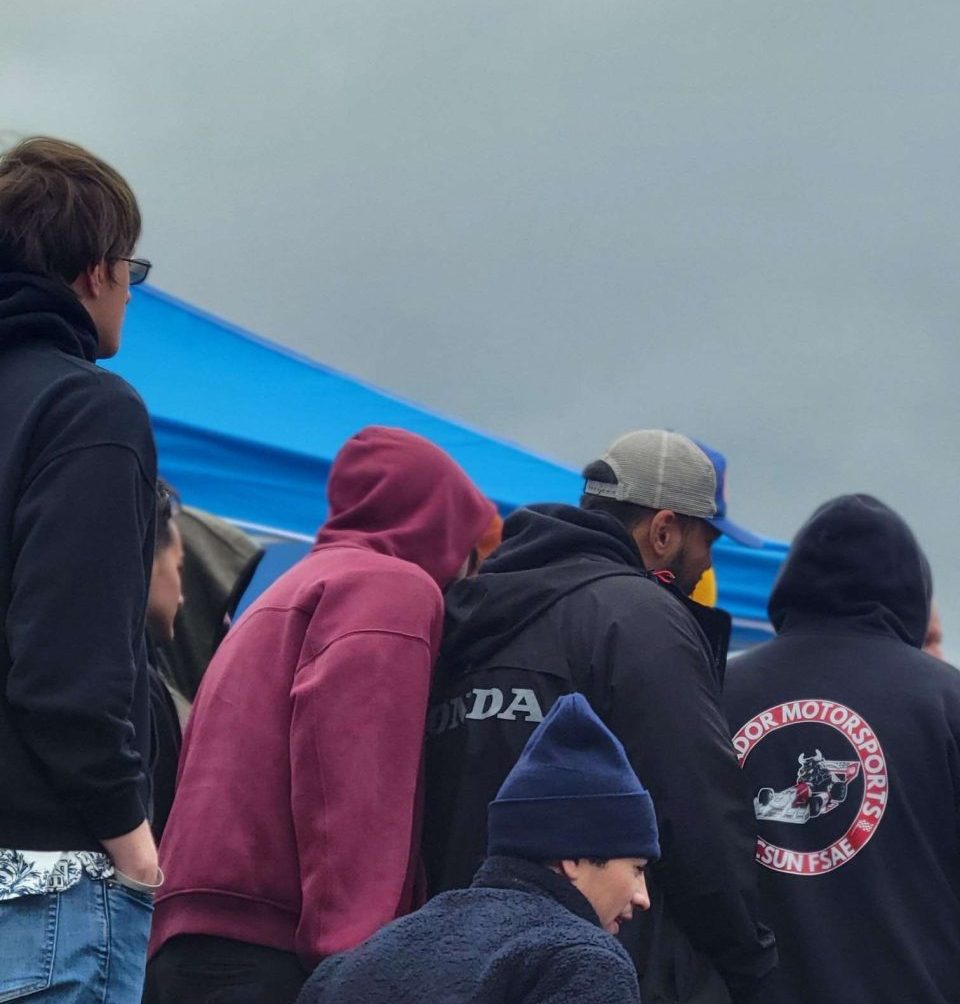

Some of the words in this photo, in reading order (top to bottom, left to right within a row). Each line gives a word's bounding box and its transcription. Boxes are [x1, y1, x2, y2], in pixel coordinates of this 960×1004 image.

[428, 688, 545, 732] ONDA
[732, 711, 780, 758] DOR
[781, 701, 888, 820] MOTORSPORTS
[808, 838, 855, 873] FSAE
